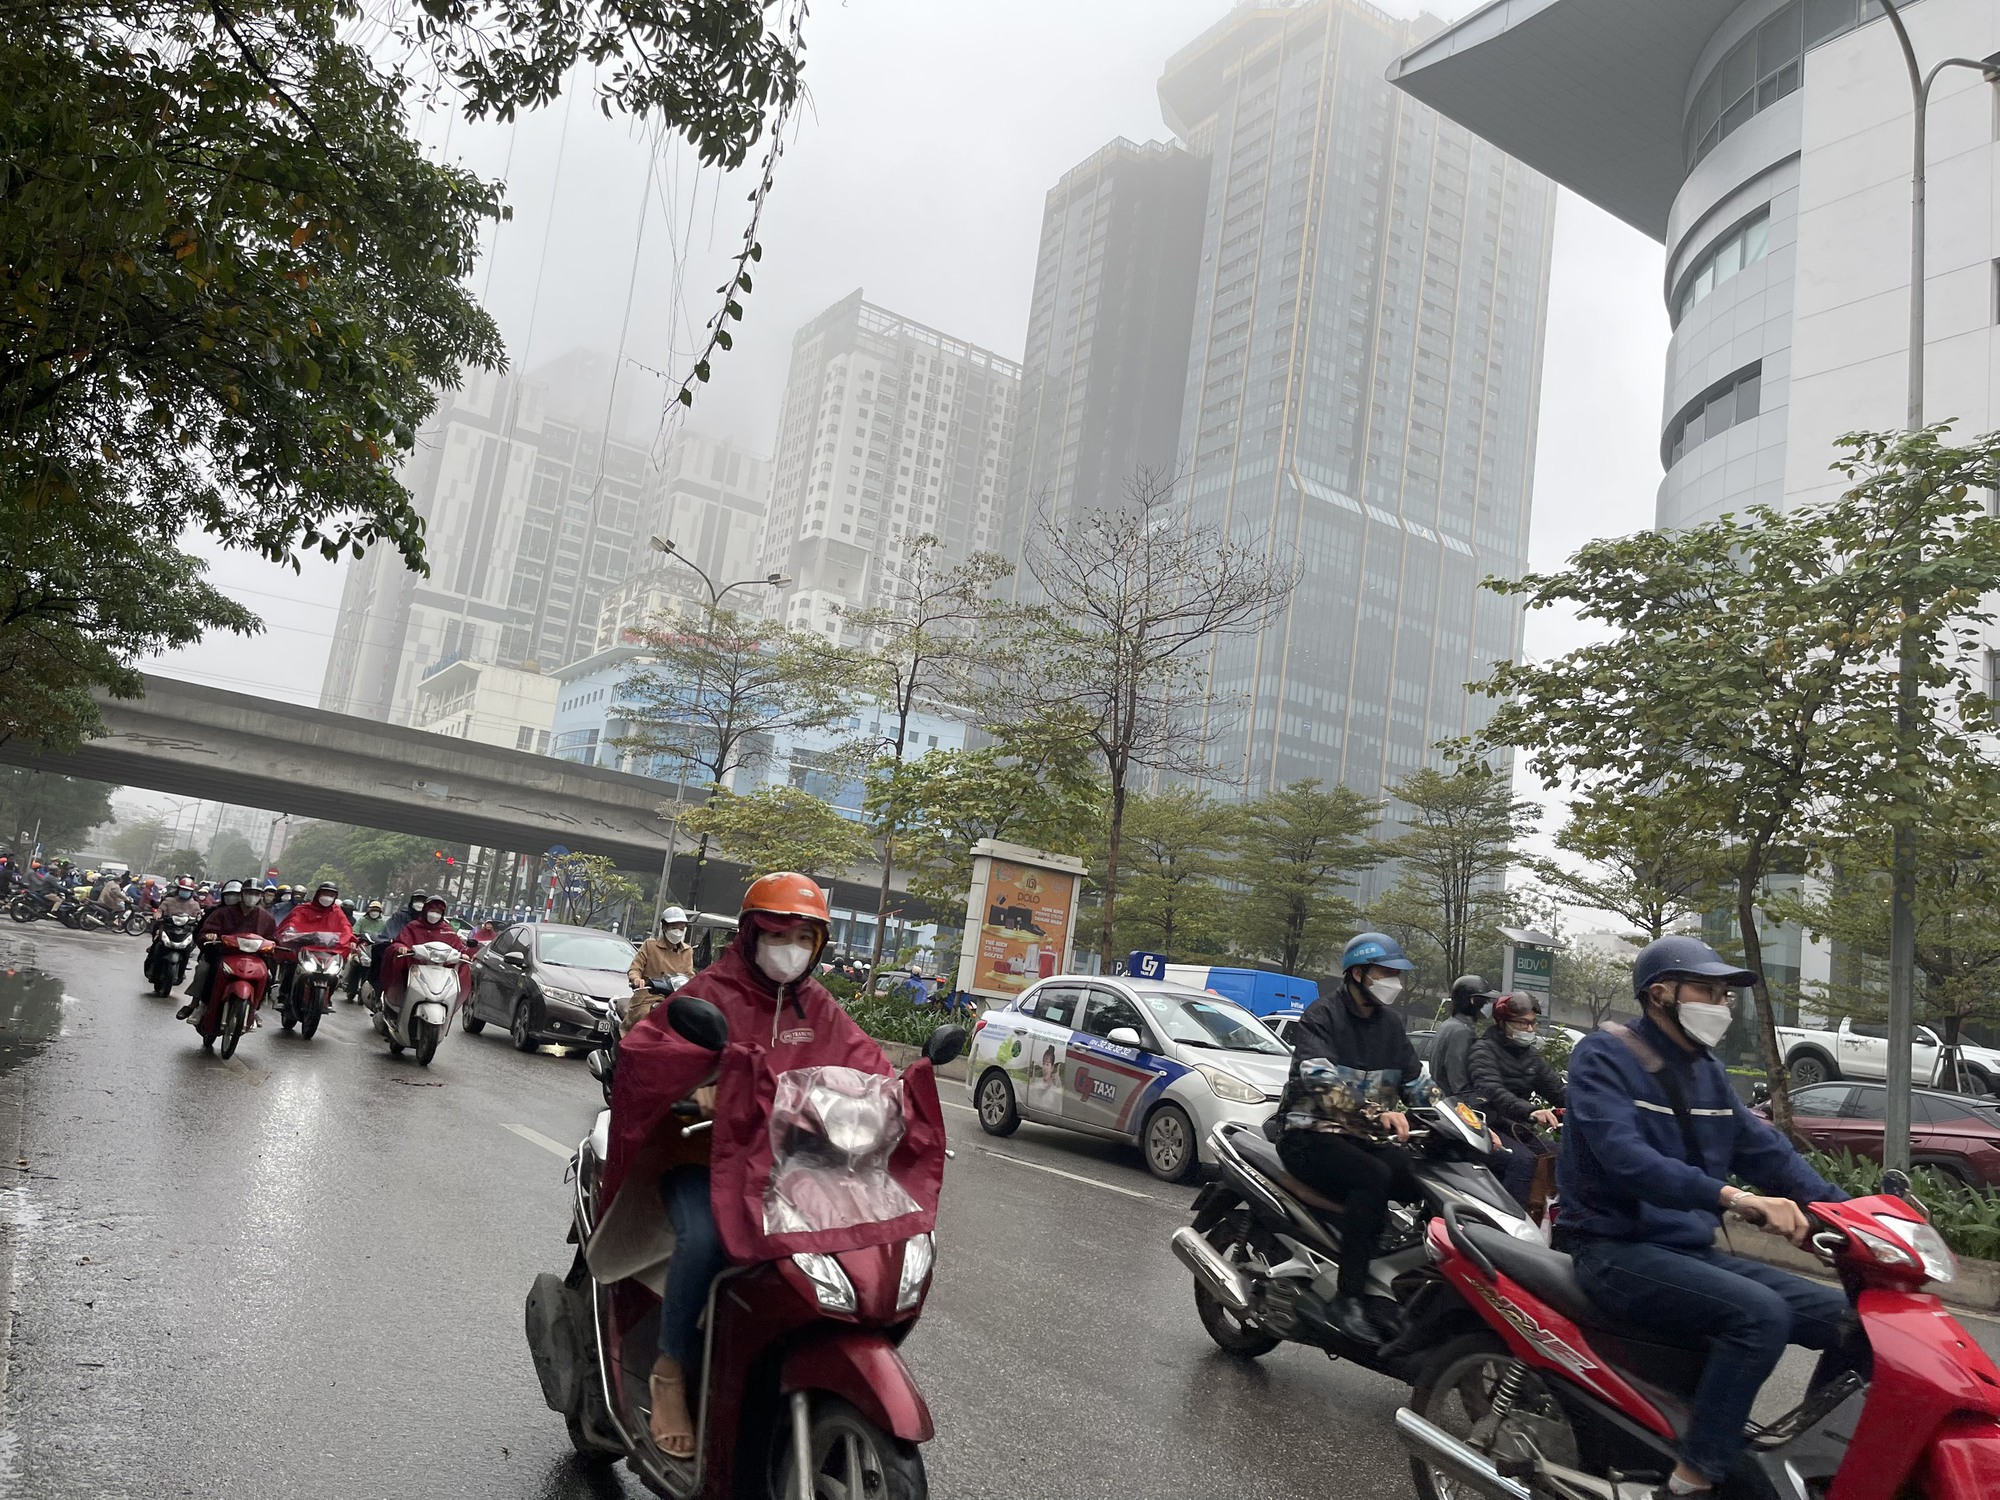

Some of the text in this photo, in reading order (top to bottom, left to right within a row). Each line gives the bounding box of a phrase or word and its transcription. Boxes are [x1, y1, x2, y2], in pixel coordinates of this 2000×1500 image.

[1017, 892, 1040, 904] DOLO
[1353, 947, 1377, 957] UBER
[1142, 955, 1159, 977] G7
[1517, 957, 1540, 970] BIDV
[599, 1022, 610, 1031] 30
[1093, 1080, 1116, 1099] TAXI
